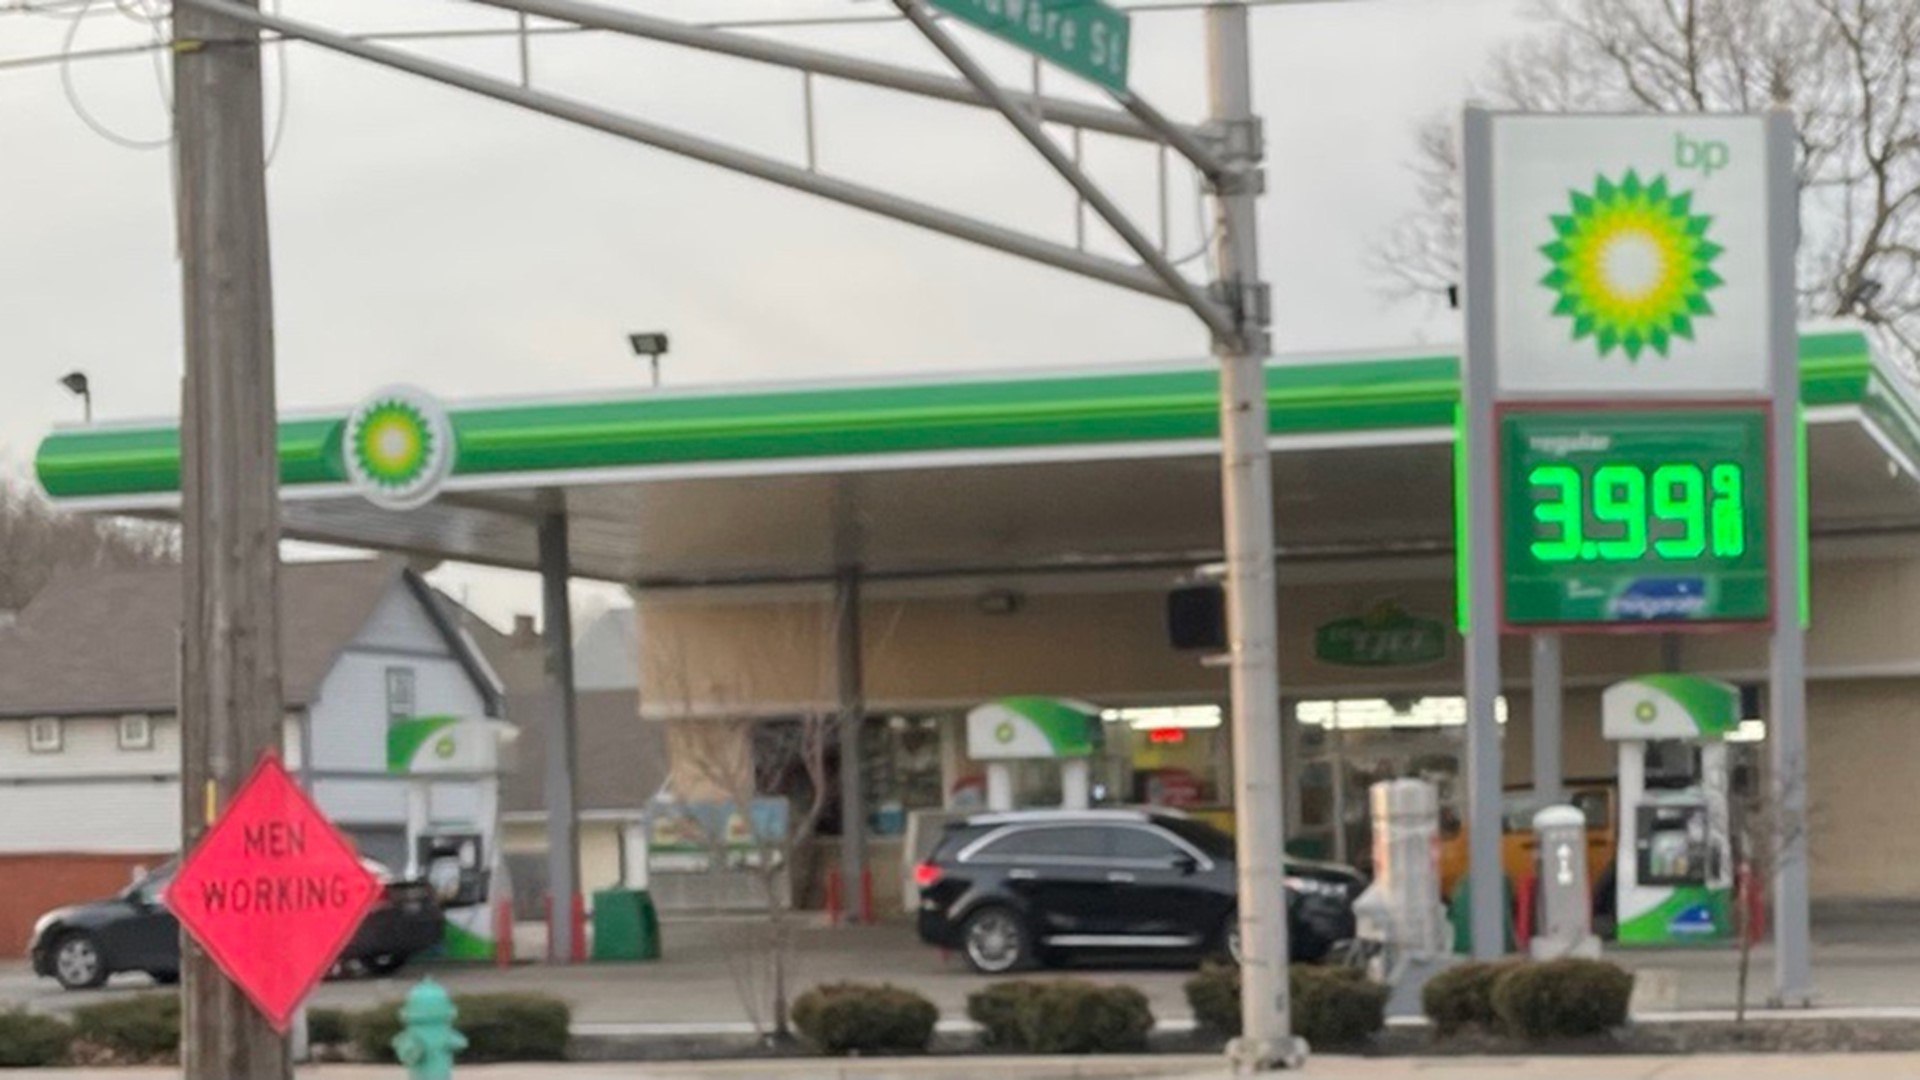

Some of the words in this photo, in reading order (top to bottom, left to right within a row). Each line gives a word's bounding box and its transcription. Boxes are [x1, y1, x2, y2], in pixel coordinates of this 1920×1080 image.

[1674, 130, 1729, 177] bp
[1528, 464, 1706, 561] 3.99
[243, 821, 306, 857] MEN
[202, 874, 348, 914] WORKING
